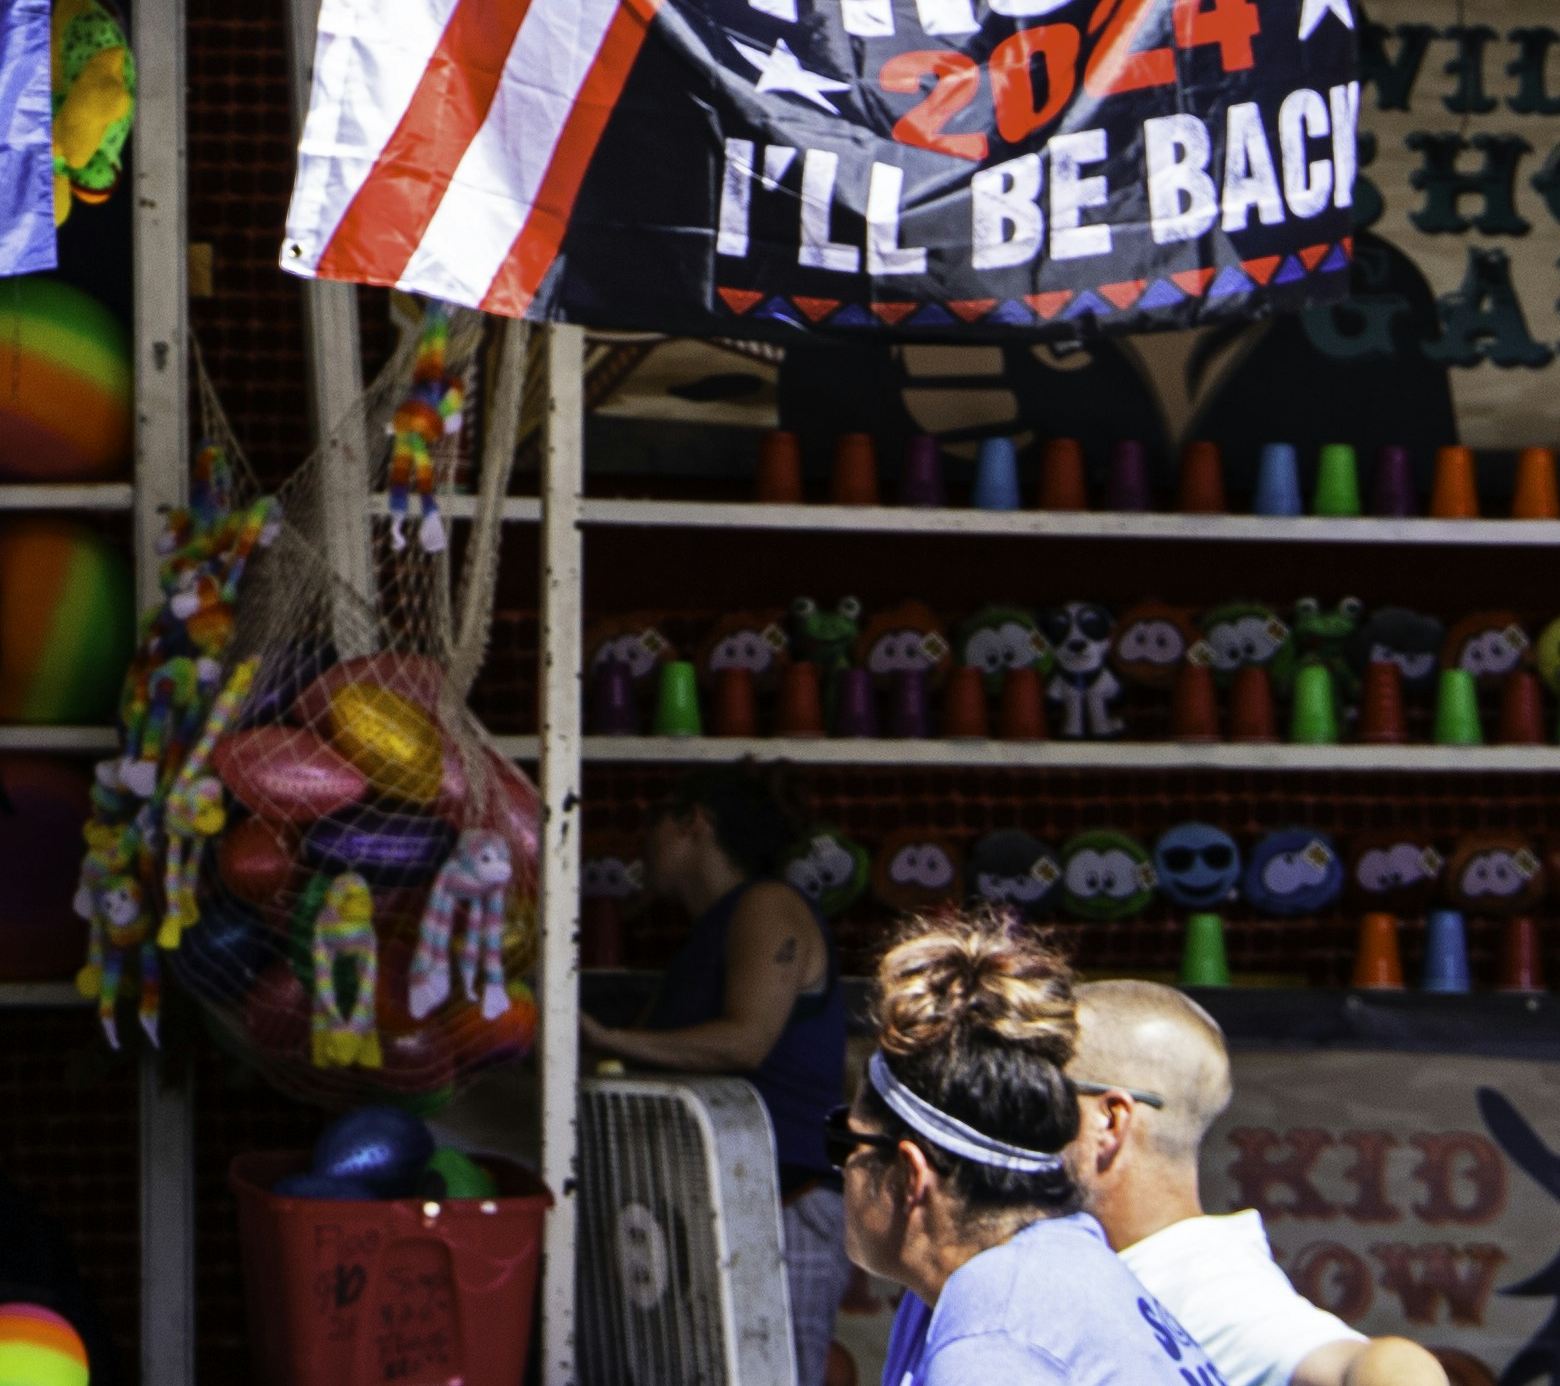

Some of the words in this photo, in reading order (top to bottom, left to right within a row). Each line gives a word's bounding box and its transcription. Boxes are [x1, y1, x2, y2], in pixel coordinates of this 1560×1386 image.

[716, 137, 929, 275] I'LL
[971, 128, 1111, 271] BE
[1227, 1127, 1510, 1227] KID
